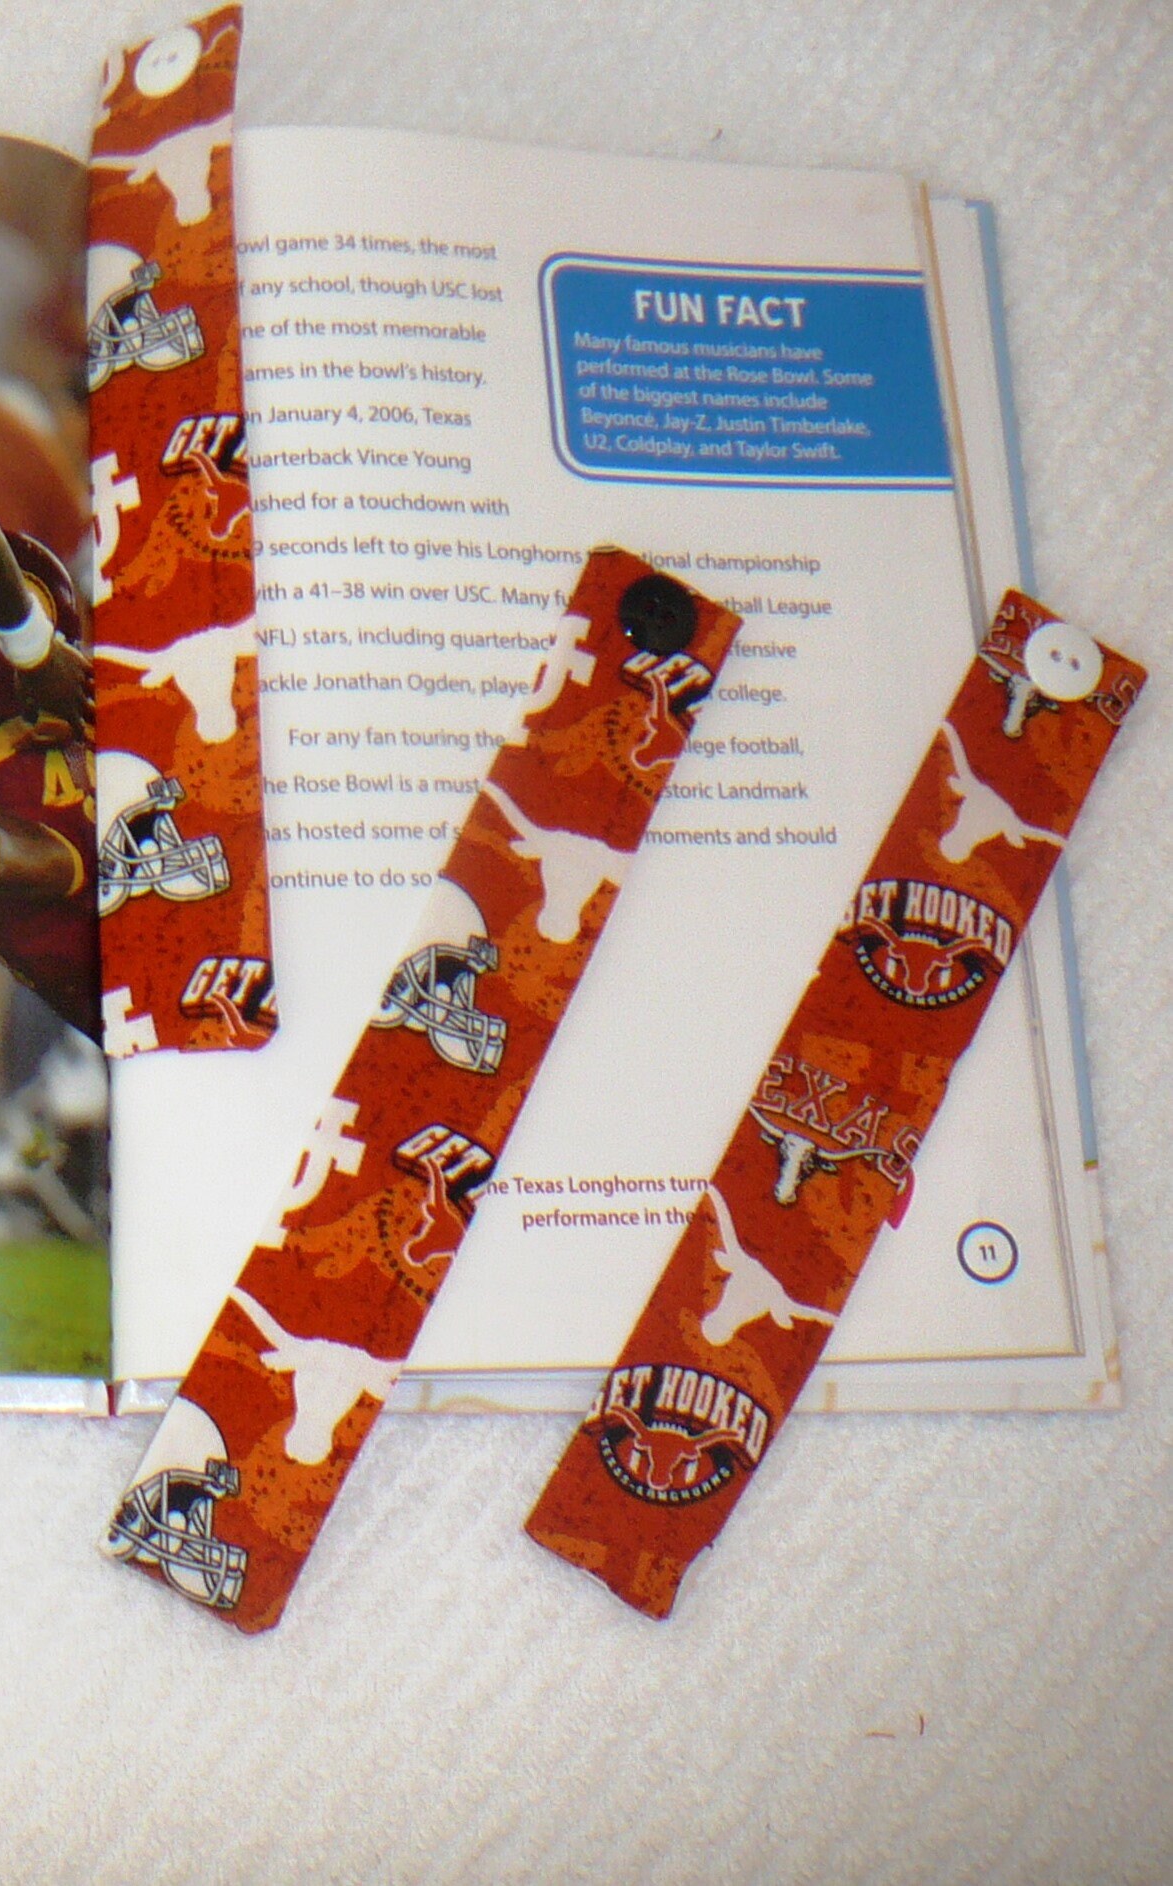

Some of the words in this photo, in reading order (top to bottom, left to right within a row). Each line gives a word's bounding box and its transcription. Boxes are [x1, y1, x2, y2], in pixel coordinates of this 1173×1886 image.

[237, 235, 270, 255] owl
[276, 237, 329, 256] game
[334, 234, 356, 252] 34
[361, 235, 416, 255] times,
[420, 238, 449, 256] the
[453, 243, 497, 261] most
[251, 281, 283, 299] any
[290, 276, 355, 295] school,
[359, 277, 427, 299] though
[432, 282, 470, 300] USC
[473, 284, 504, 302] lost
[634, 289, 704, 324] FUN
[717, 294, 806, 328] FACT
[242, 325, 265, 339] ne
[271, 319, 290, 336] of
[295, 318, 326, 336] the
[332, 320, 378, 336] most
[383, 321, 487, 343] memorable
[574, 331, 622, 353] Many
[625, 334, 690, 354] famous
[694, 339, 778, 359] musicians
[781, 342, 823, 361] have
[244, 366, 295, 381] ames
[300, 362, 317, 379] in
[323, 361, 354, 379] the
[577, 358, 669, 378] performed
[674, 366, 691, 380] at
[694, 364, 723, 380] the
[727, 365, 768, 383] Rose
[772, 367, 820, 385] Bowl.
[823, 369, 874, 386] Some
[578, 382, 597, 398] of
[601, 384, 629, 400] the
[633, 385, 698, 407] biggest
[703, 393, 760, 409] names
[765, 392, 828, 410] include
[269, 406, 343, 426] January
[347, 406, 364, 424] 4,
[369, 406, 419, 425] 2006,
[425, 407, 473, 427] Texas
[716, 416, 766, 433] Justin
[770, 417, 872, 438] Timberlake,
[160, 413, 241, 466] GET
[616, 435, 695, 457] Coldplay,
[699, 441, 732, 457] and
[735, 441, 788, 461] Taylor
[249, 447, 352, 468] uarterback
[357, 449, 409, 467] Vince
[413, 450, 472, 473] Young
[253, 493, 306, 512] ushed
[311, 491, 339, 510] for
[344, 496, 354, 510] a
[359, 493, 466, 514] touchdown
[471, 498, 510, 516] with
[270, 537, 348, 556] seconds
[354, 537, 386, 555] left
[391, 539, 409, 555] to
[415, 540, 453, 560] give
[457, 540, 482, 558] his
[488, 542, 583, 566] Longhorns
[696, 553, 821, 576] championship
[293, 587, 304, 600] a
[371, 583, 405, 602] win
[410, 587, 450, 602] over
[455, 585, 496, 604] USC.
[502, 587, 554, 610] Many
[768, 599, 833, 619] League
[303, 629, 353, 647] stars,
[358, 627, 445, 649] including
[450, 632, 552, 656] quarterbac
[314, 672, 403, 692] Jonathan
[407, 673, 476, 695] Ogden,
[481, 676, 529, 697] playe
[289, 728, 320, 746] For
[326, 732, 361, 751] any
[366, 727, 397, 746] fan
[402, 729, 471, 751] touring
[475, 730, 506, 747] the
[687, 738, 726, 759] lege
[730, 736, 805, 757] football,
[263, 776, 288, 794] he
[294, 775, 341, 793] Rose
[346, 774, 394, 793] Bowl
[399, 776, 413, 793] is
[418, 780, 429, 793] a
[434, 777, 480, 795] must
[665, 781, 713, 800] storic
[718, 781, 809, 800] Landmark
[297, 821, 366, 841] hosted
[371, 825, 424, 841] some
[429, 820, 450, 840] of
[647, 829, 732, 846] moments
[736, 828, 771, 846] and
[776, 828, 837, 846] should
[270, 870, 349, 889] ontinue
[354, 871, 375, 888] to
[380, 869, 404, 888] do
[410, 873, 433, 888] so
[903, 880, 1013, 967] HOOKED
[180, 957, 267, 1008] GET
[752, 1056, 924, 1196] EXAS
[395, 1123, 494, 1184] GET
[513, 1176, 564, 1195] Texas
[569, 1175, 666, 1198] Longhorns
[670, 1175, 709, 1192] turn
[522, 1208, 640, 1232] performance
[644, 1207, 662, 1226] in
[979, 1244, 996, 1262] 11
[654, 1365, 769, 1464] HOOKED
